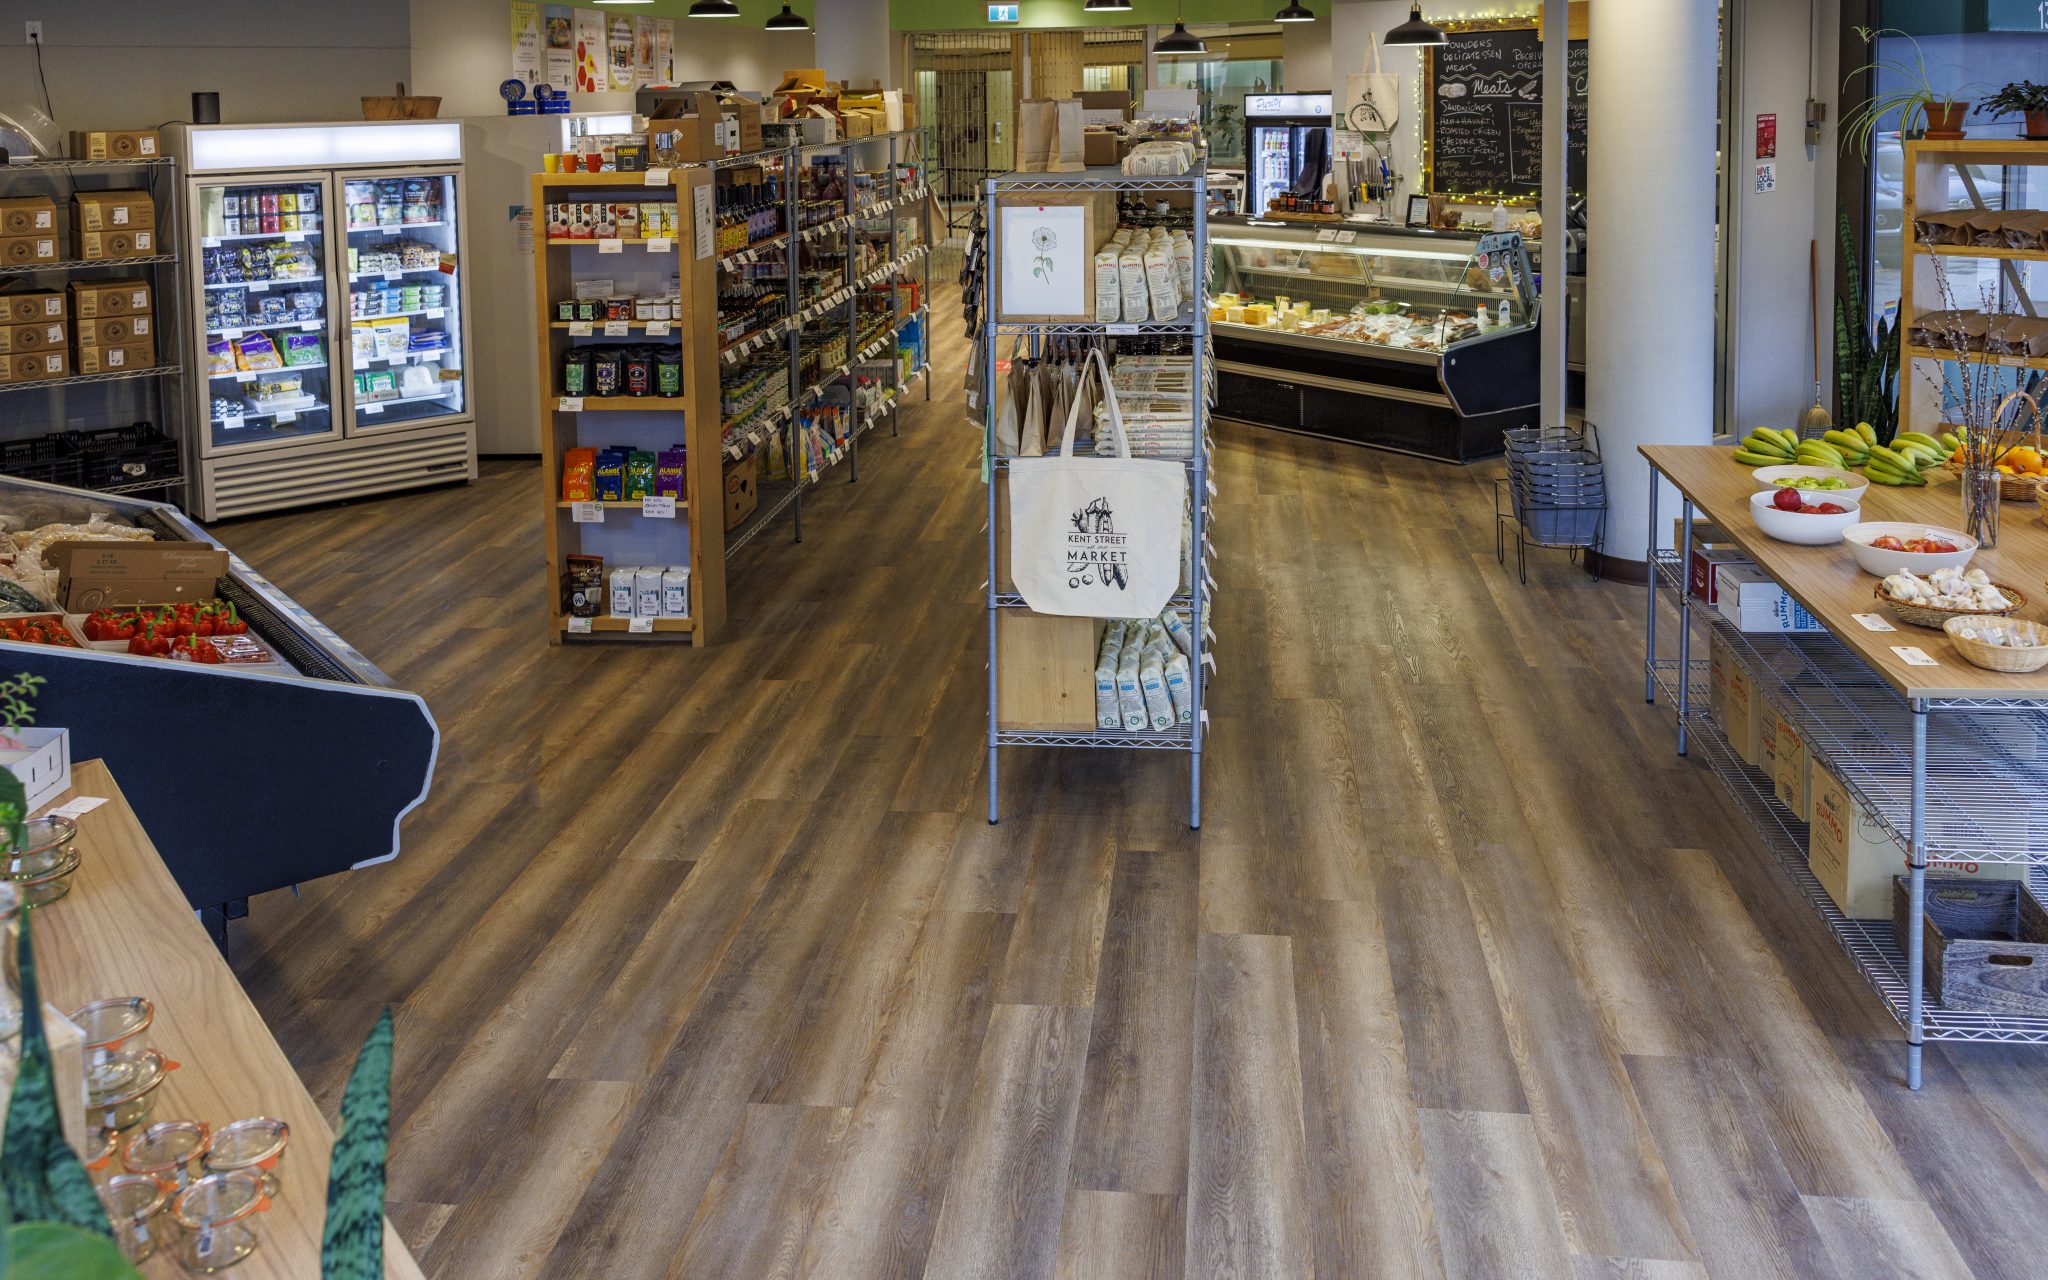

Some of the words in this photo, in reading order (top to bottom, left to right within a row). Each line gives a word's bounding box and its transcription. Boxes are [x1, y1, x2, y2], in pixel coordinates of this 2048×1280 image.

[1472, 77, 1516, 94] Meats
[1068, 535, 1091, 543] KENT
[1094, 535, 1126, 544] STREET
[1068, 552, 1126, 562] MARKET
[1778, 722, 1800, 749] RUMMO
[1816, 802, 1843, 843] RUMMO
